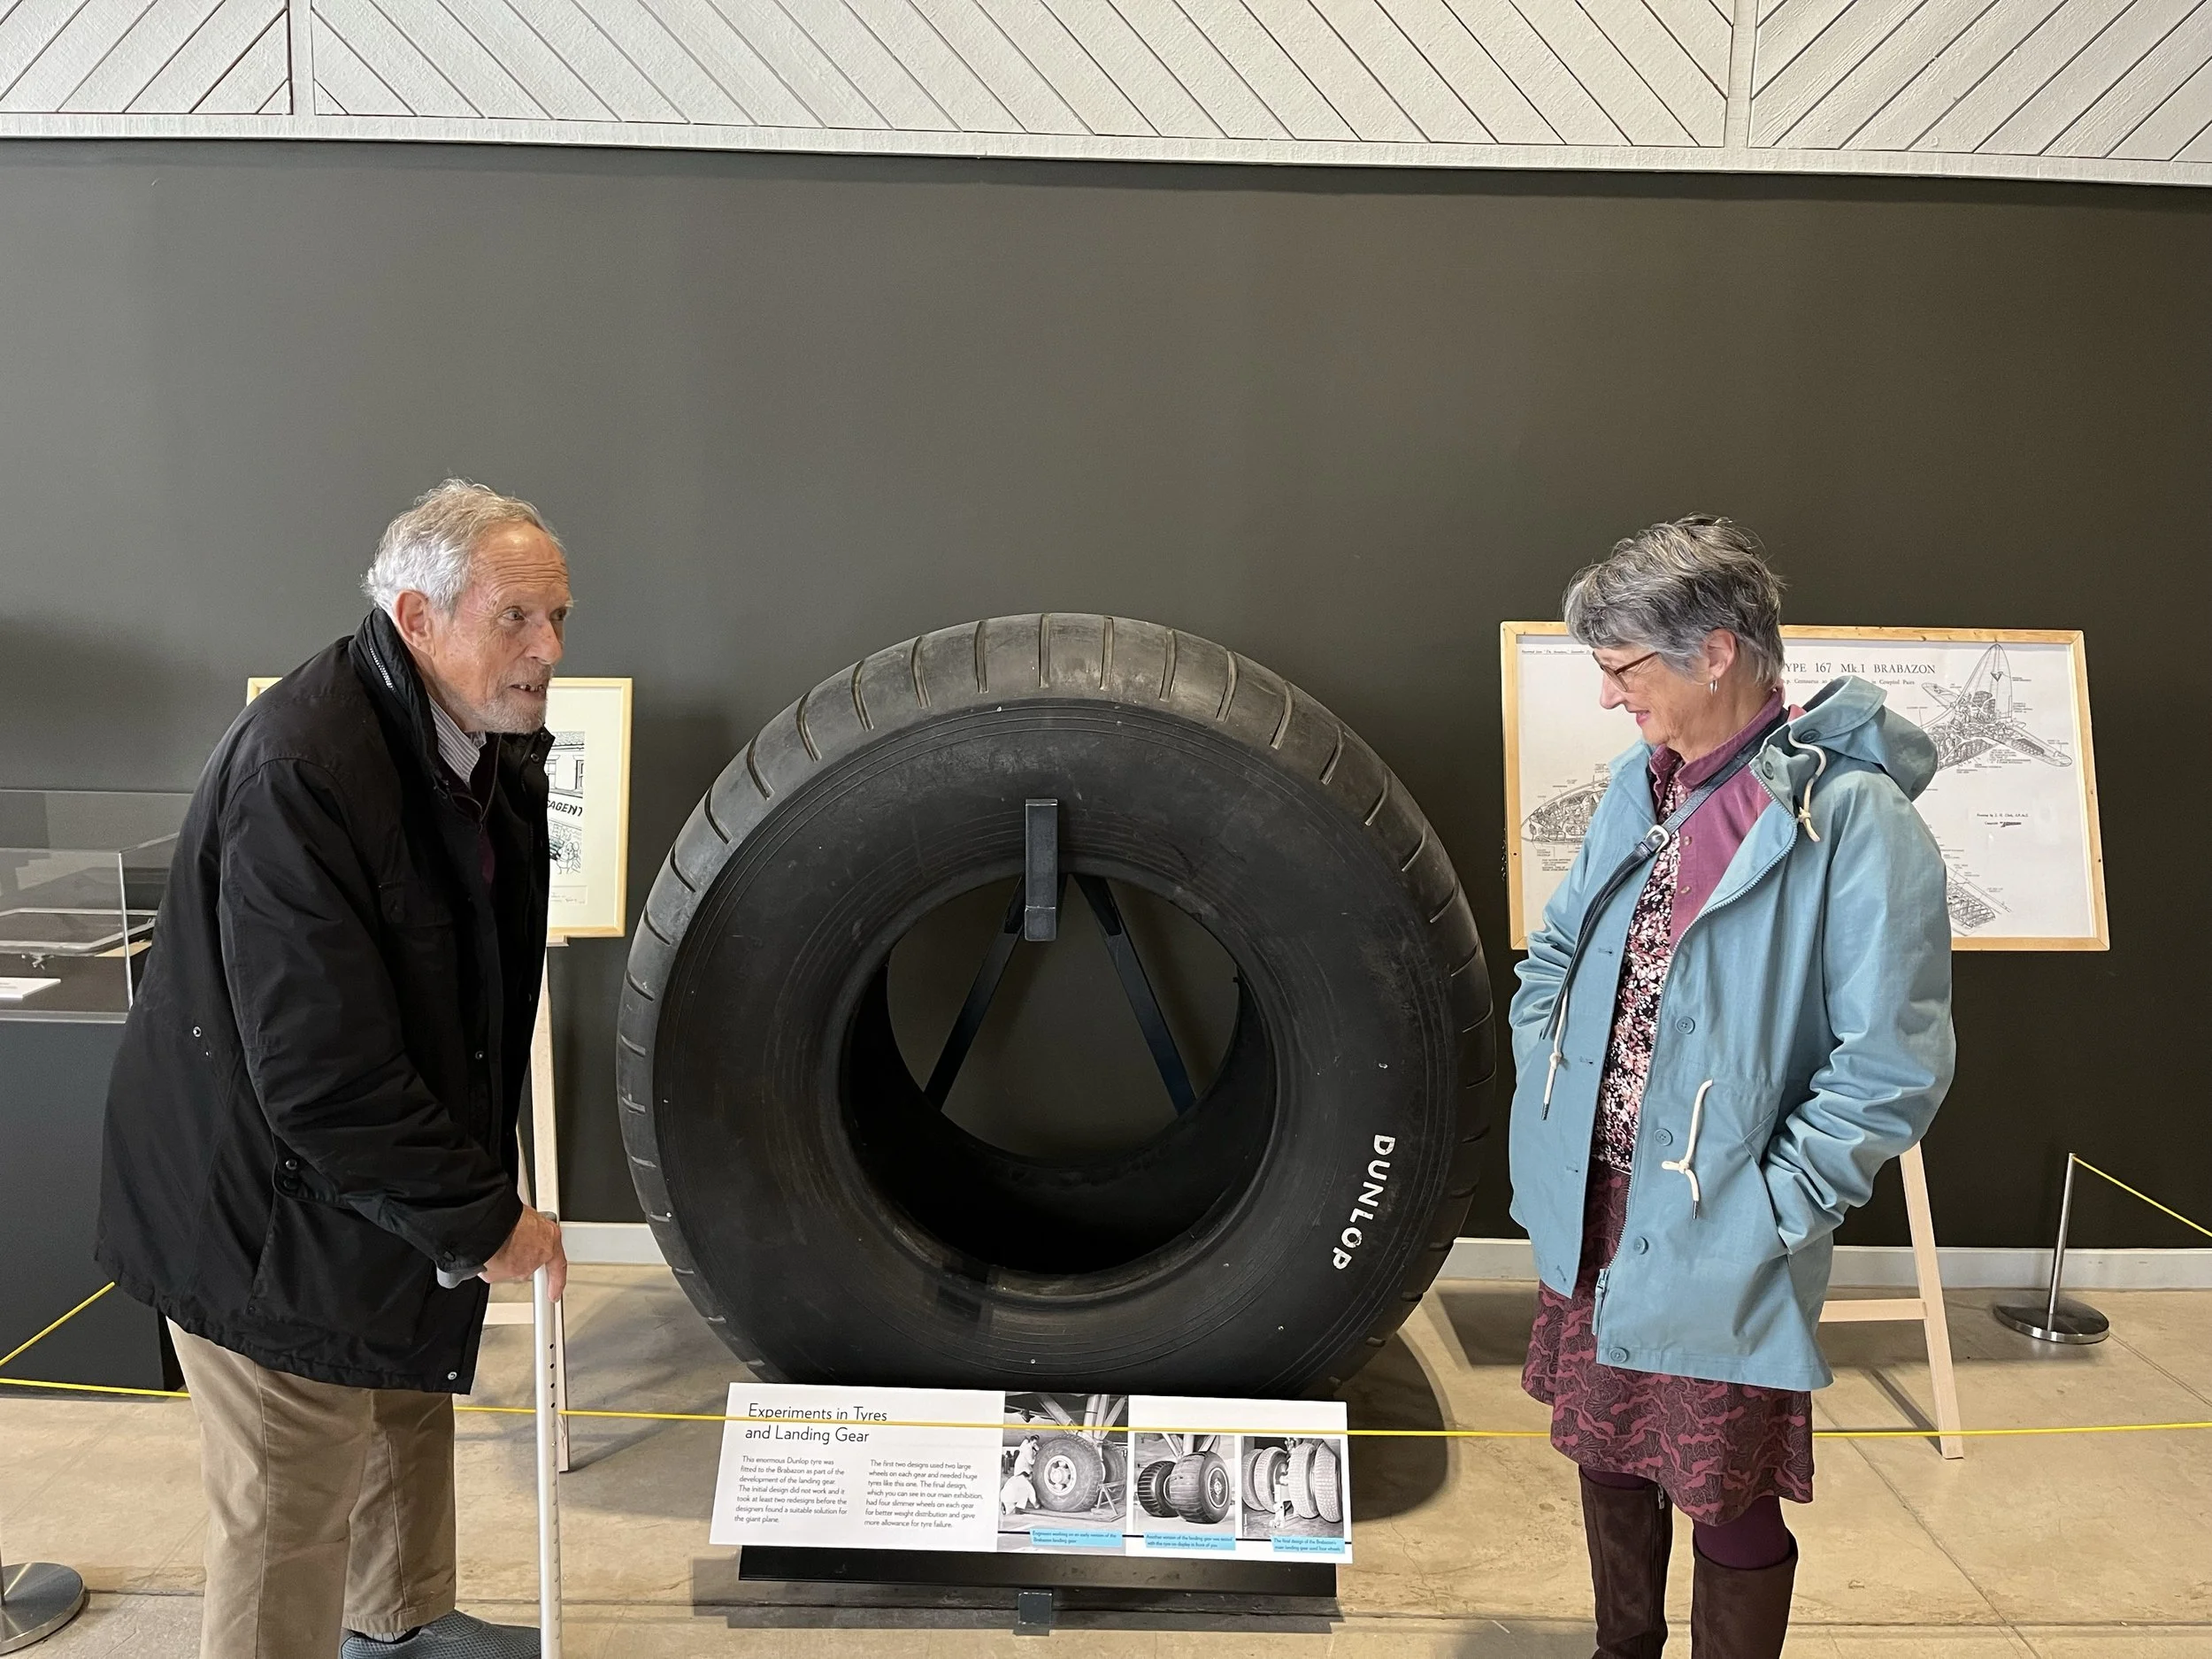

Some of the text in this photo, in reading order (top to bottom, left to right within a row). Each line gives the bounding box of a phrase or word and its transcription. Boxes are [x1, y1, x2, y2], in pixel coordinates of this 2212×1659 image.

[1785, 663, 1807, 672] YPE
[1816, 663, 1832, 672] 167
[1874, 664, 1935, 673] BRABAZON
[548, 800, 583, 817] AGENT
[1333, 1134, 1395, 1270] DUNLOP
[749, 1402, 887, 1422] Experiments in Tyres
[745, 1425, 869, 1445] and Landing Gear
[799, 1477, 820, 1486] landing
[735, 1505, 763, 1514] designers
